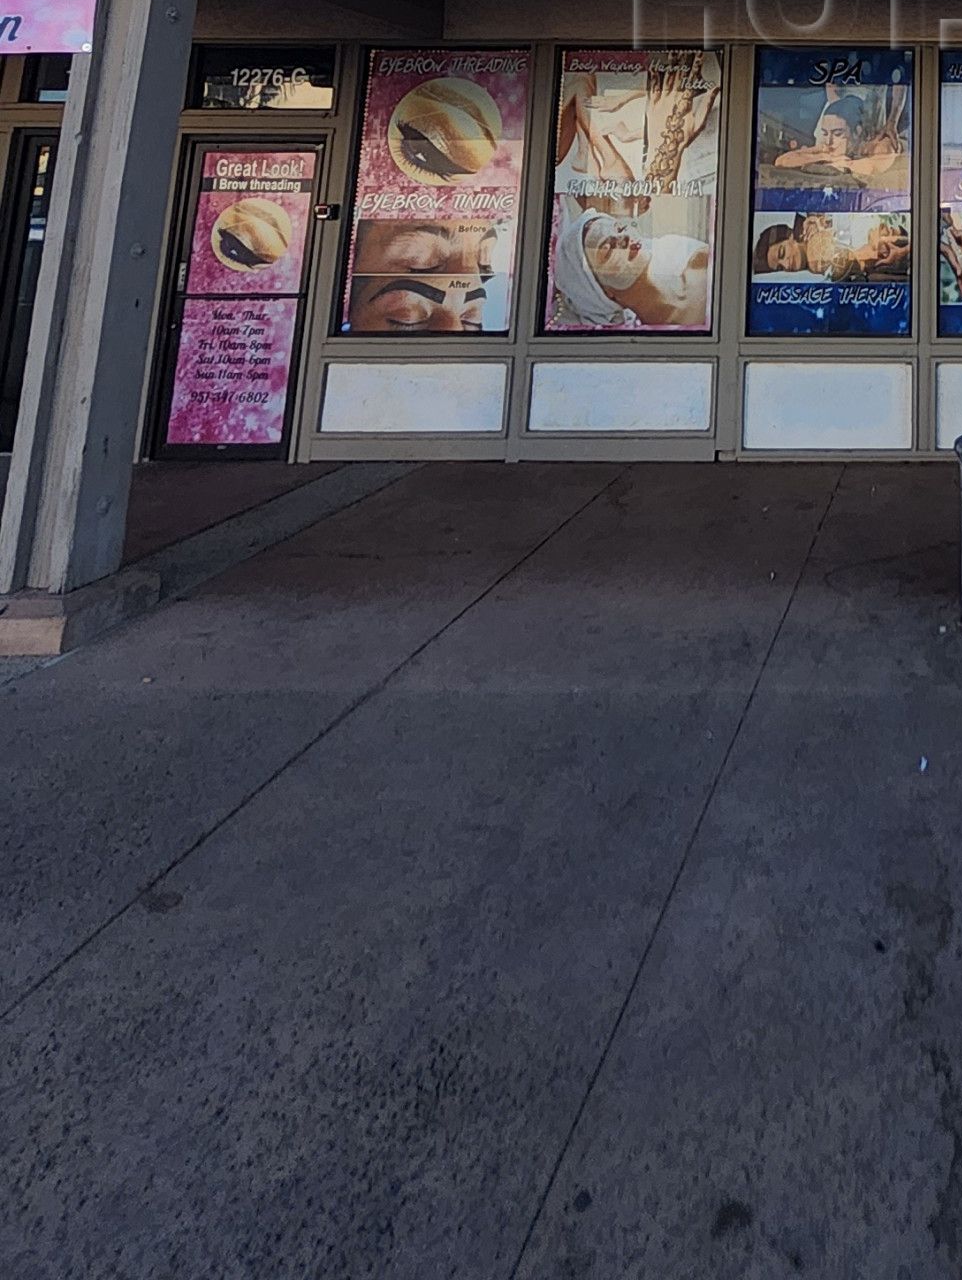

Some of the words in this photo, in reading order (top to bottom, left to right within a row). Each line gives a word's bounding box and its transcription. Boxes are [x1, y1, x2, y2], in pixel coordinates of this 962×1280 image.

[379, 57, 446, 76] EYEBROW
[450, 57, 527, 72] THREADING
[569, 58, 599, 74] Body
[601, 60, 642, 76] Waxing
[808, 58, 862, 86] SPA
[216, 158, 257, 177] Great
[261, 159, 305, 178] Look!
[219, 178, 248, 190] Brow
[249, 179, 302, 193] threading
[622, 180, 664, 197] BODY
[361, 193, 448, 212] EYEBROW
[452, 194, 514, 210] TINTING
[458, 225, 487, 233] Before
[448, 280, 472, 289] After
[756, 286, 834, 304] MASSAGE
[838, 286, 905, 309] THERAPY
